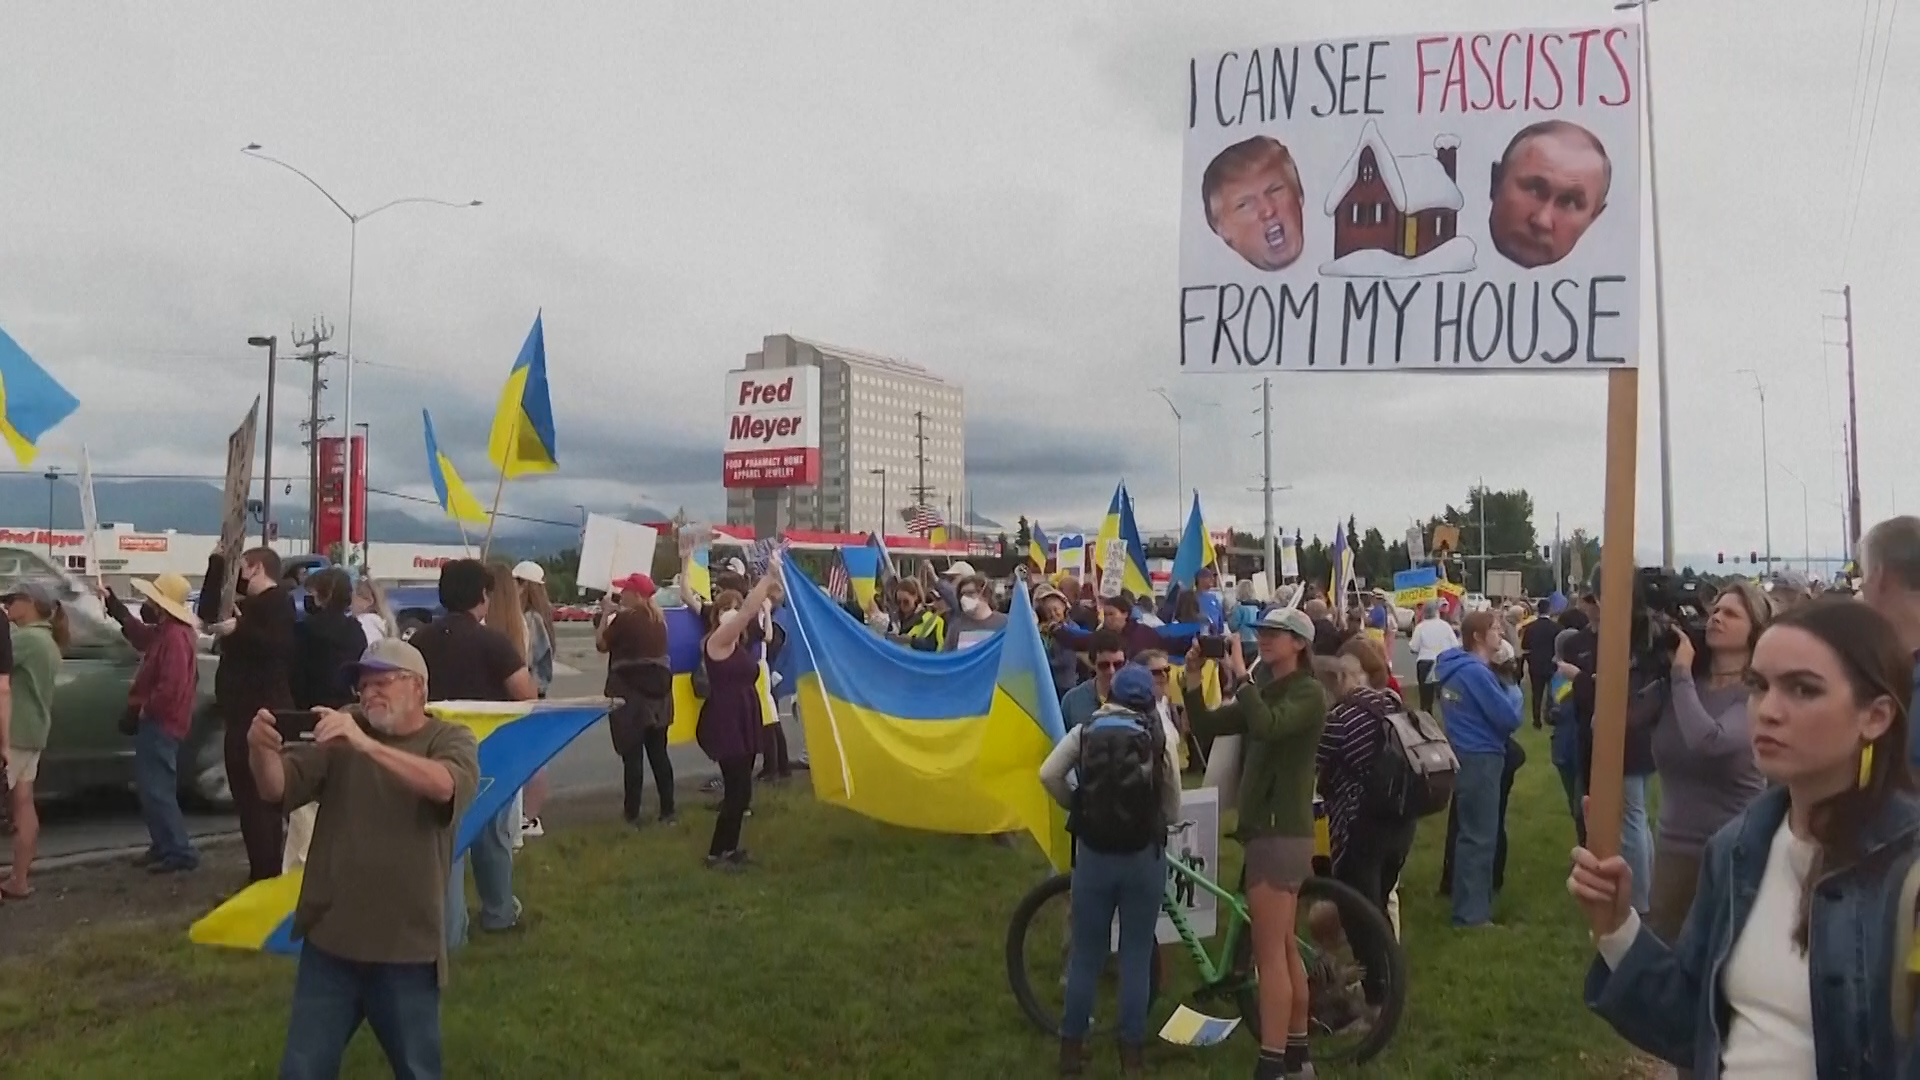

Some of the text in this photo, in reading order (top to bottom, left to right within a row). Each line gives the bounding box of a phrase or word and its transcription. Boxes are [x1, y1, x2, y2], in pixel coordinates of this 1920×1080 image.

[1190, 28, 1632, 128] I CAN SEE FASCISTS
[1179, 275, 1626, 367] FROM MY HOUSE
[739, 376, 793, 406] Fred
[729, 414, 801, 443] Meyer
[726, 455, 804, 469] FOOD PHARMACY HOME
[734, 467, 794, 479] APPAREL JEWELRY
[36, 531, 84, 547] Meyer
